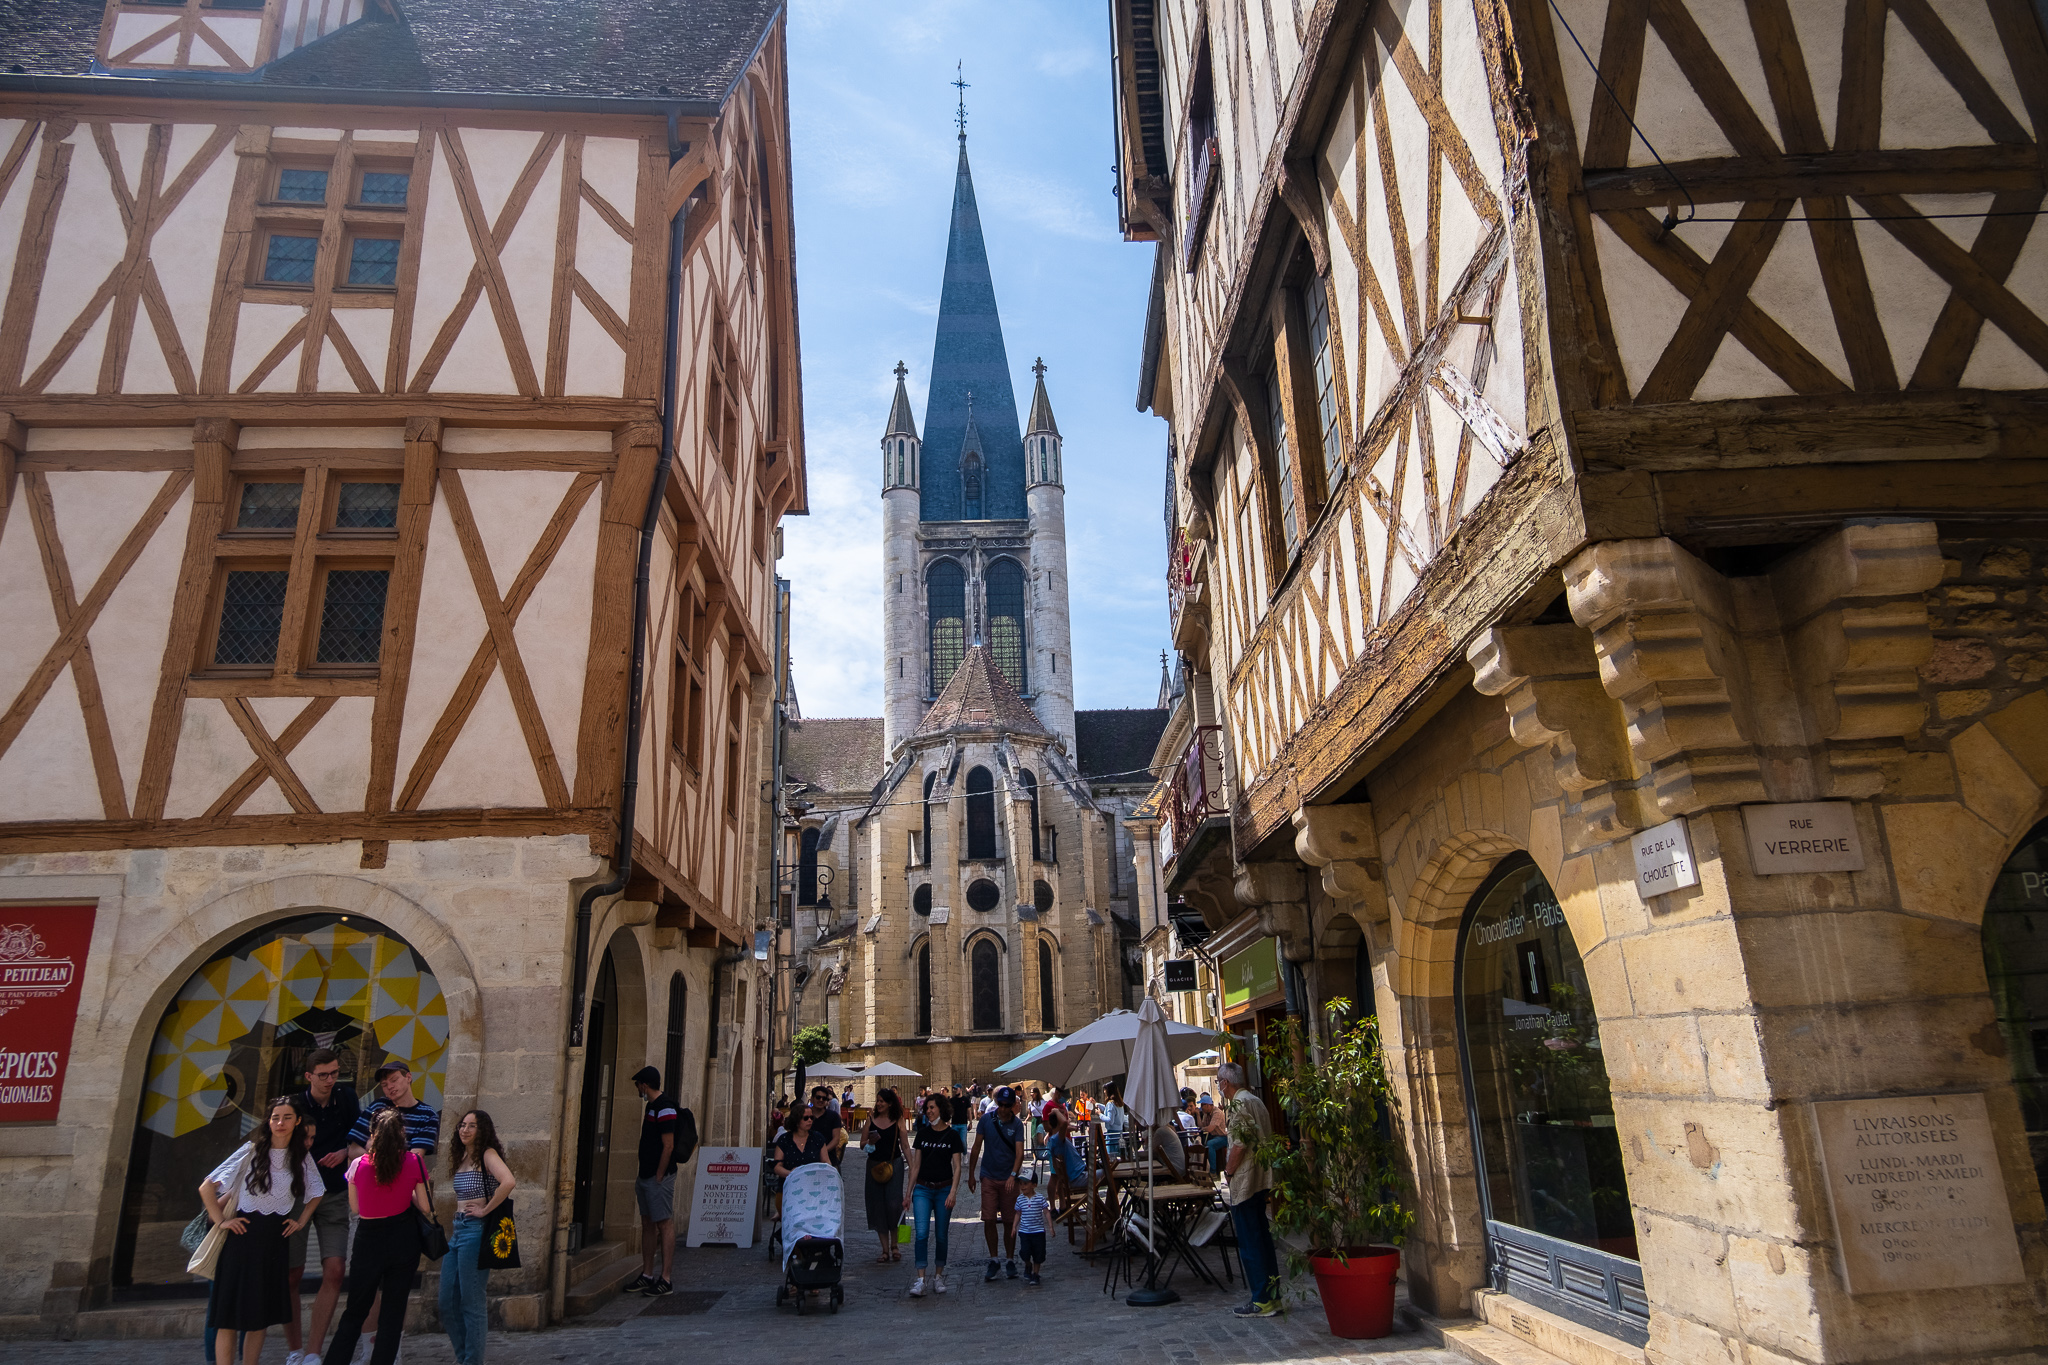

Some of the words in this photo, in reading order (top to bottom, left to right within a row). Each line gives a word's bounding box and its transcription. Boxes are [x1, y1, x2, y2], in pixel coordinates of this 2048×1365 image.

[1788, 819, 1813, 829] RUE
[1641, 845, 1654, 857] RUE
[1655, 841, 1664, 852] DE
[1666, 838, 1675, 848] LA
[1765, 838, 1850, 855] VERRERIE
[1643, 860, 1686, 884] CHOUETTE
[1475, 912, 1525, 945] Chocolatier
[4, 967, 67, 982] PETITJEAN
[26, 990, 58, 998] D'ÉPICES
[1515, 1014, 1546, 1030] Jonathan
[1853, 1114, 1955, 1131] LIVRAISONS
[1856, 1129, 1958, 1147] AUTORISEES
[1860, 1158, 1907, 1170] LUNDI
[1916, 1153, 1965, 1167] MARDI
[1844, 1169, 1922, 1185] VENDREDI
[1927, 1167, 1984, 1181] SAMEDI
